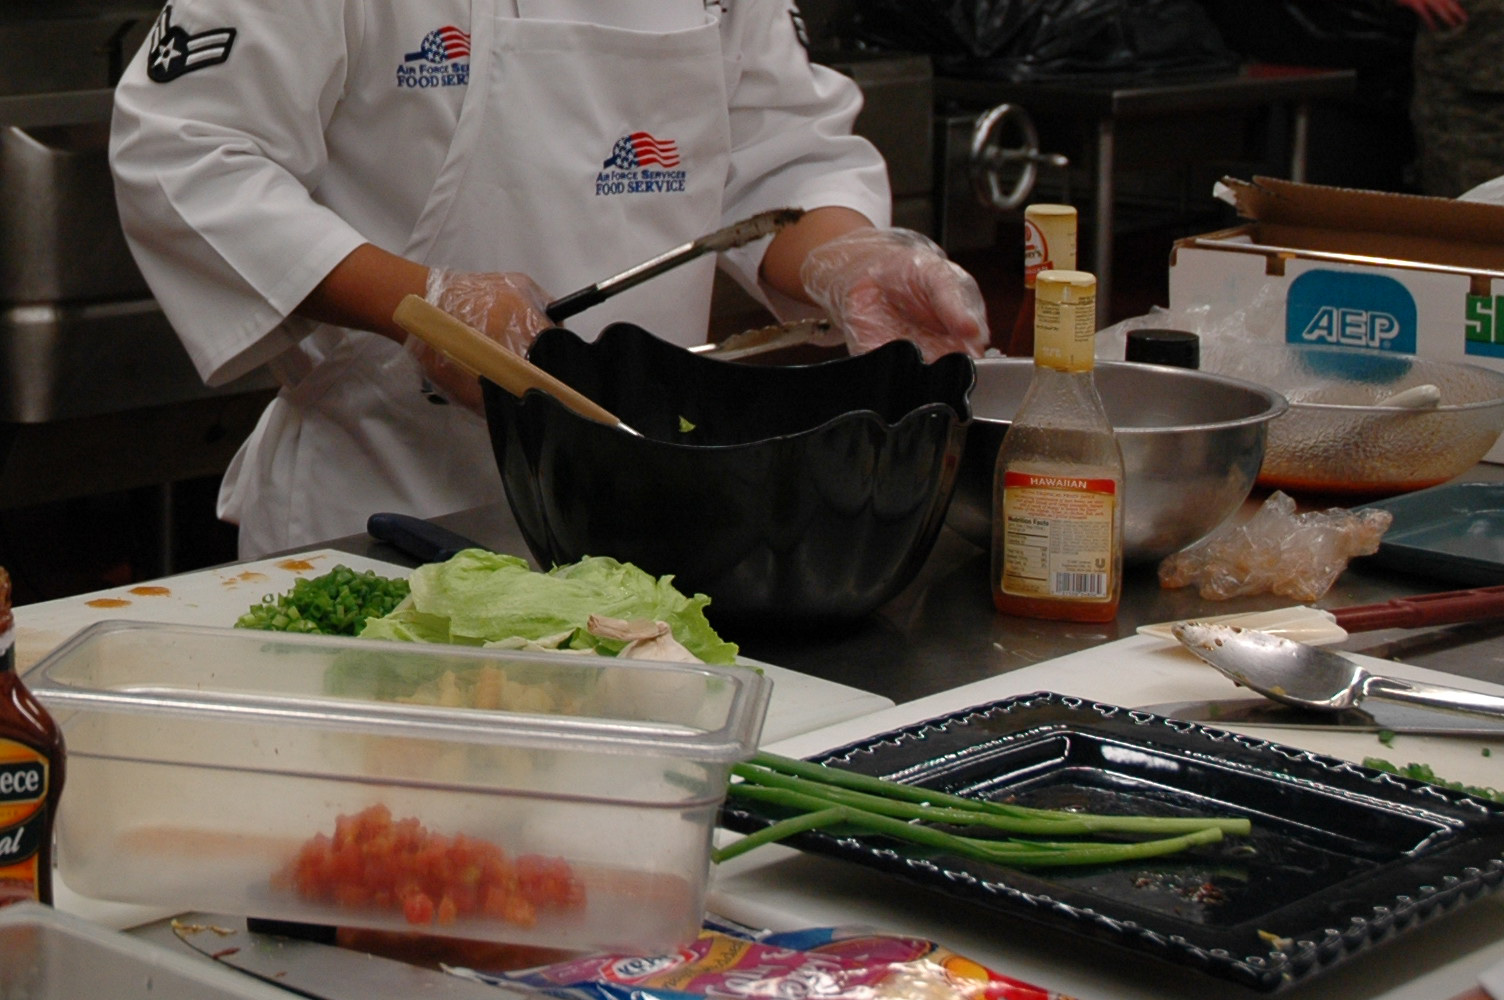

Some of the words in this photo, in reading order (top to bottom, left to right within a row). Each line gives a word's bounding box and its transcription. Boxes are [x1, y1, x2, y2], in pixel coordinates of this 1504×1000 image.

[397, 75, 439, 88] FOOD
[595, 182, 625, 196] FOOD
[627, 179, 686, 193] SERVICE
[1301, 305, 1400, 348] AEP
[1030, 477, 1088, 489] HAWAIIAN
